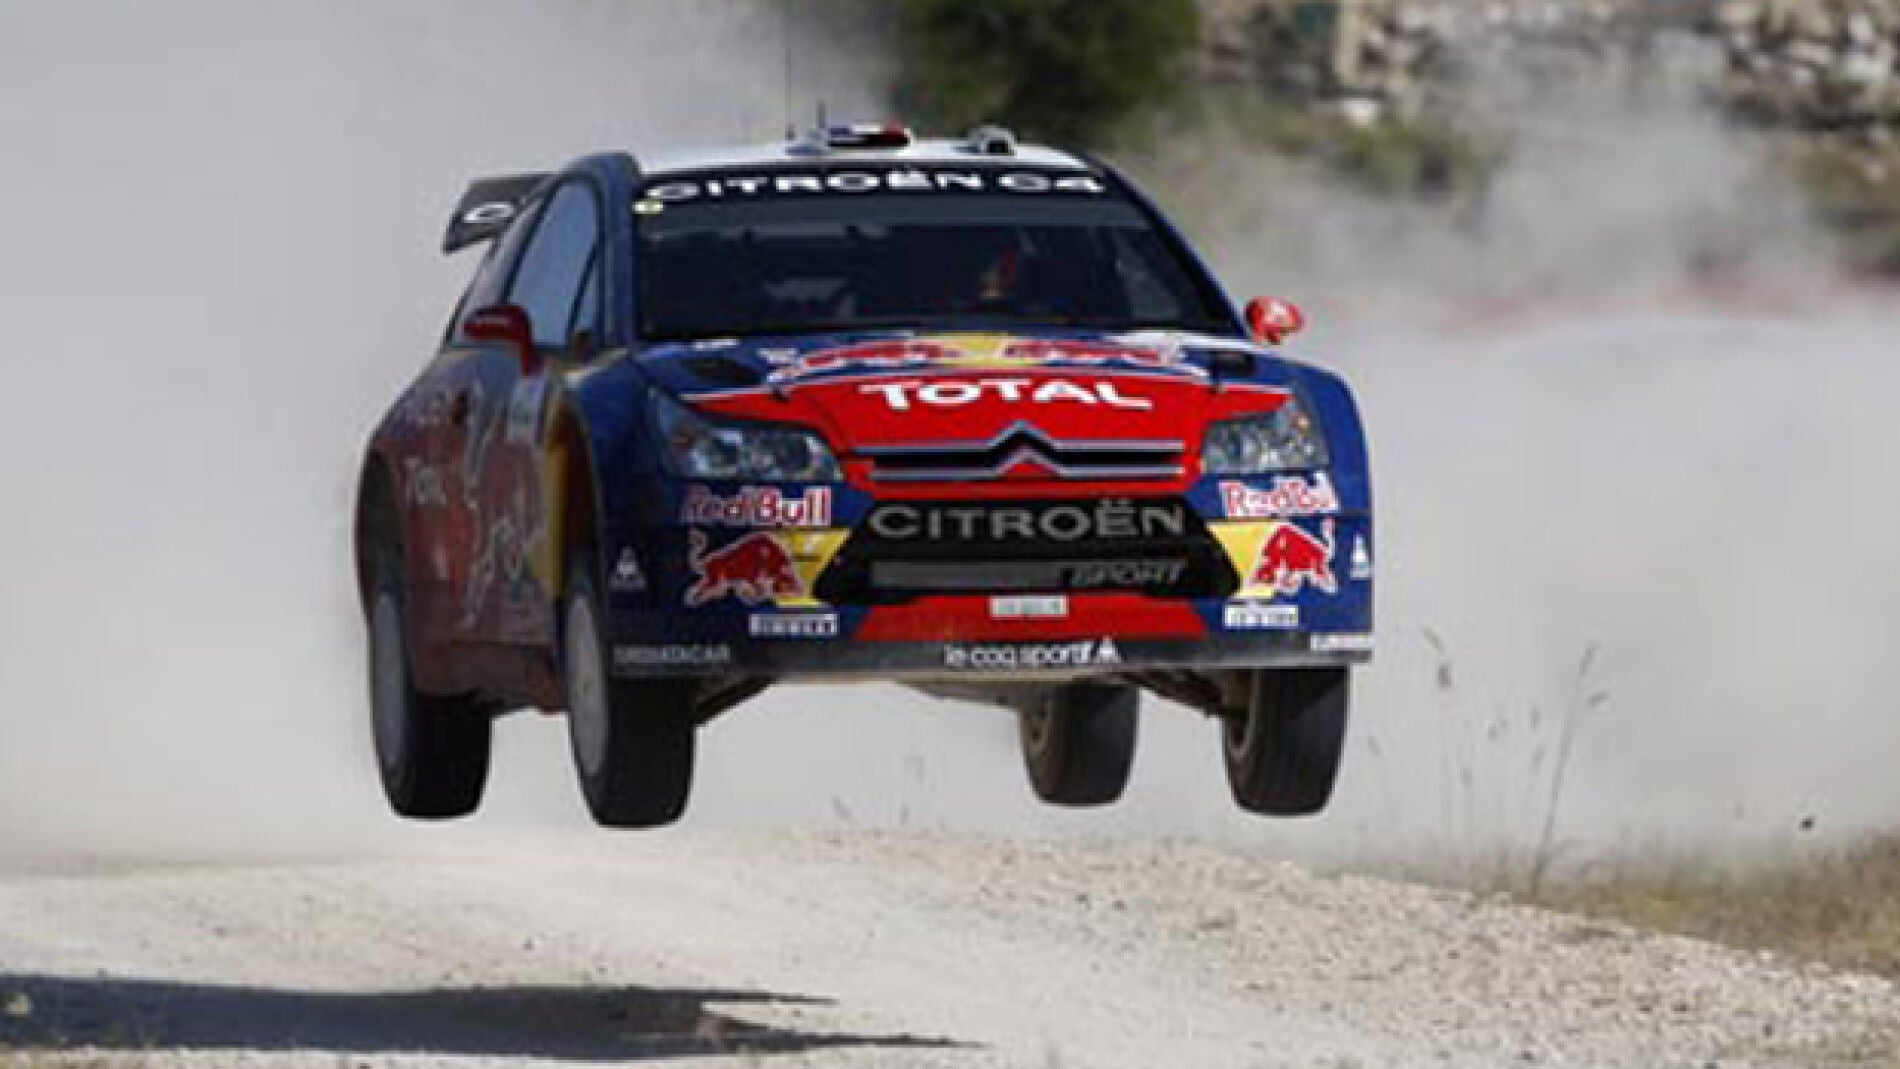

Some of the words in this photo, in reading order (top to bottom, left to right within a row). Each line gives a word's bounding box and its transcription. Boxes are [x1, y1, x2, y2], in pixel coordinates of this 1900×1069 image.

[859, 378, 1153, 410] TOTAL
[749, 486, 832, 526] Bull
[870, 498, 1185, 540] CITROËN
